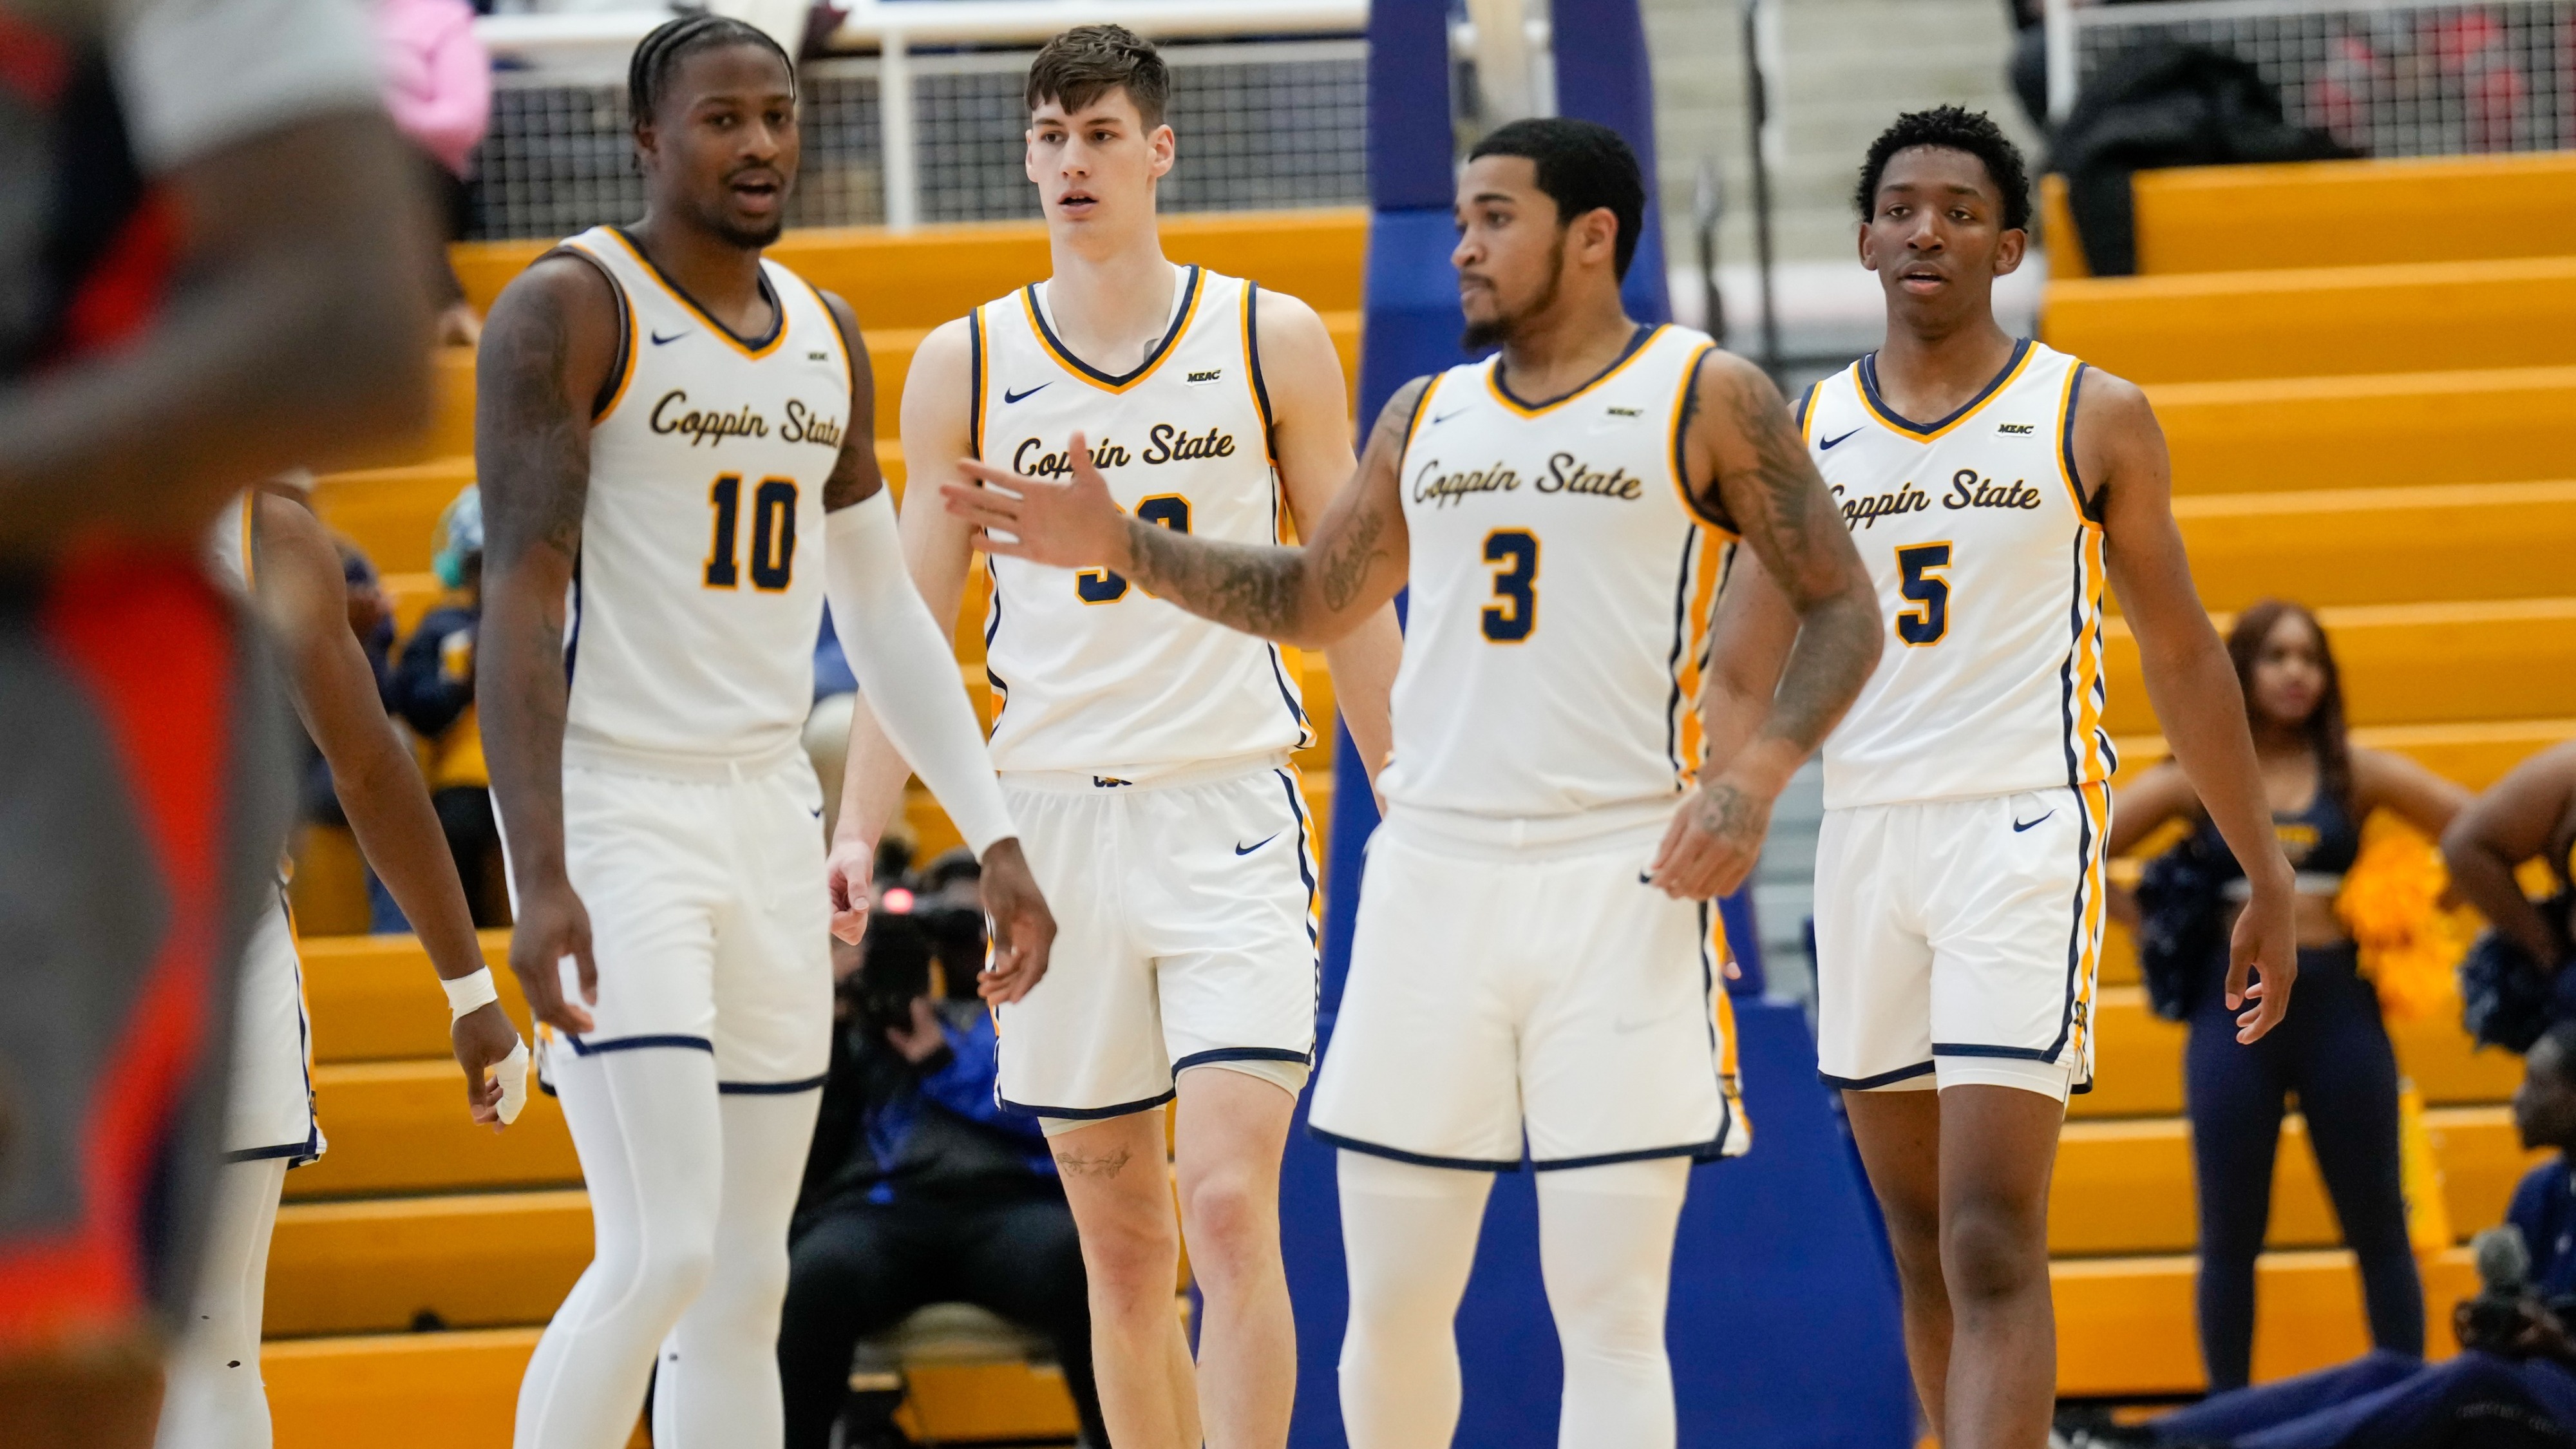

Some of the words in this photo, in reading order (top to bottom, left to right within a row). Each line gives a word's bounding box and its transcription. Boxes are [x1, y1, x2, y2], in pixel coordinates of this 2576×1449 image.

[1188, 369, 1222, 383] MEAC
[650, 389, 768, 447] Coppin
[1142, 424, 1235, 464] State
[1998, 423, 2034, 435] MEAC
[1414, 458, 1520, 509] Coppin
[1535, 452, 1643, 500] State
[1942, 469, 2041, 510] State
[702, 471, 799, 594] 10
[1481, 526, 1540, 645] 3
[1894, 540, 1952, 648] 5
